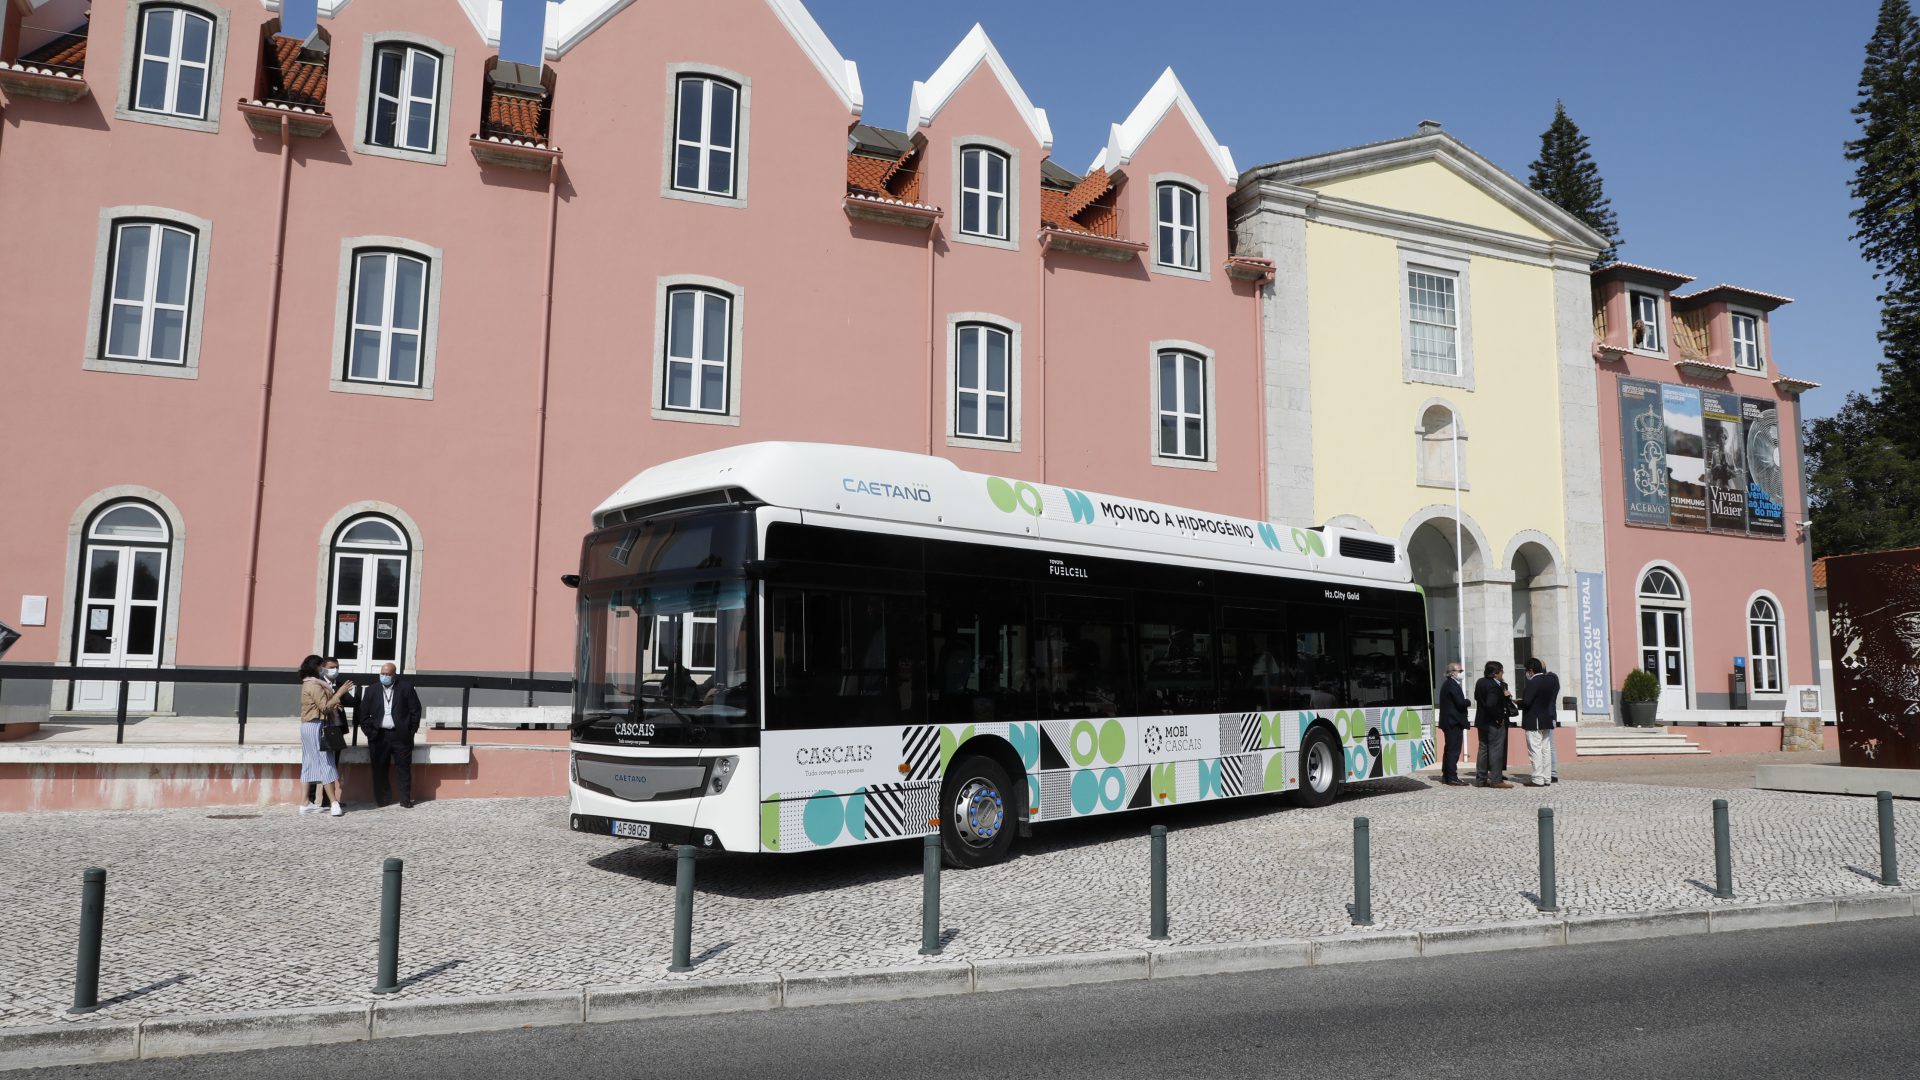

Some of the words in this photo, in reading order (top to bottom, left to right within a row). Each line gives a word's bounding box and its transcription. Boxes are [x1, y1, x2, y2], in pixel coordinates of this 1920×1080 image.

[842, 478, 931, 503] CAETANO
[1710, 485, 1744, 503] Vivian
[1630, 502, 1665, 514] ACERVO
[1670, 496, 1706, 507] STIMMUNG
[1711, 499, 1743, 517] Maier
[1101, 502, 1160, 525] MOVIDO
[1165, 512, 1175, 527] A
[1766, 510, 1781, 518] mar
[1050, 565, 1088, 578] FUELCELL
[1346, 591, 1360, 601] Gold
[1582, 577, 1592, 649] CULTURAL
[1592, 627, 1603, 687] CASCAIS
[1584, 652, 1595, 708] CENTRO
[1595, 690, 1604, 708] DE
[615, 722, 655, 737] CASCAIS
[1165, 725, 1188, 738] MOBI
[1165, 738, 1201, 752] CASCAIS
[796, 744, 873, 765] CASCAIS
[614, 774, 647, 783] CAETANO
